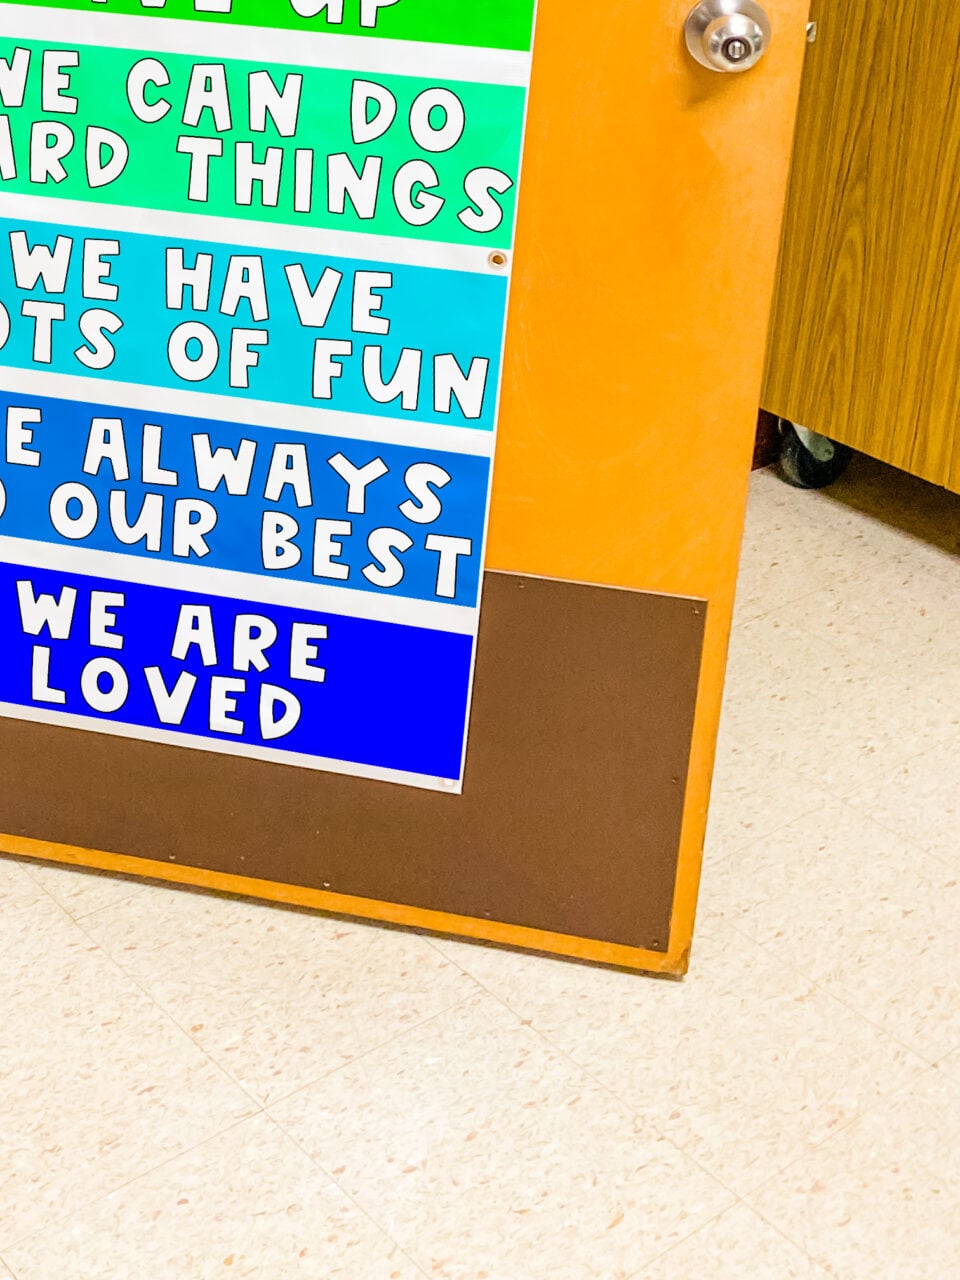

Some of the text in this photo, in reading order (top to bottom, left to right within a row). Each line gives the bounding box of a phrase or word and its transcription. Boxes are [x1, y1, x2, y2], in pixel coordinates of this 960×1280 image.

[125, 57, 304, 138] CAN
[350, 78, 466, 153] DO
[175, 134, 513, 234] THINGS
[8, 230, 393, 336] WE HAVE
[166, 320, 269, 388] OF
[311, 337, 490, 420] FUN
[81, 416, 452, 524] ALWAYS
[48, 480, 218, 559] OUR
[260, 510, 473, 599] BEST
[16, 579, 328, 684] WE ARE
[30, 644, 303, 741] LOVED
